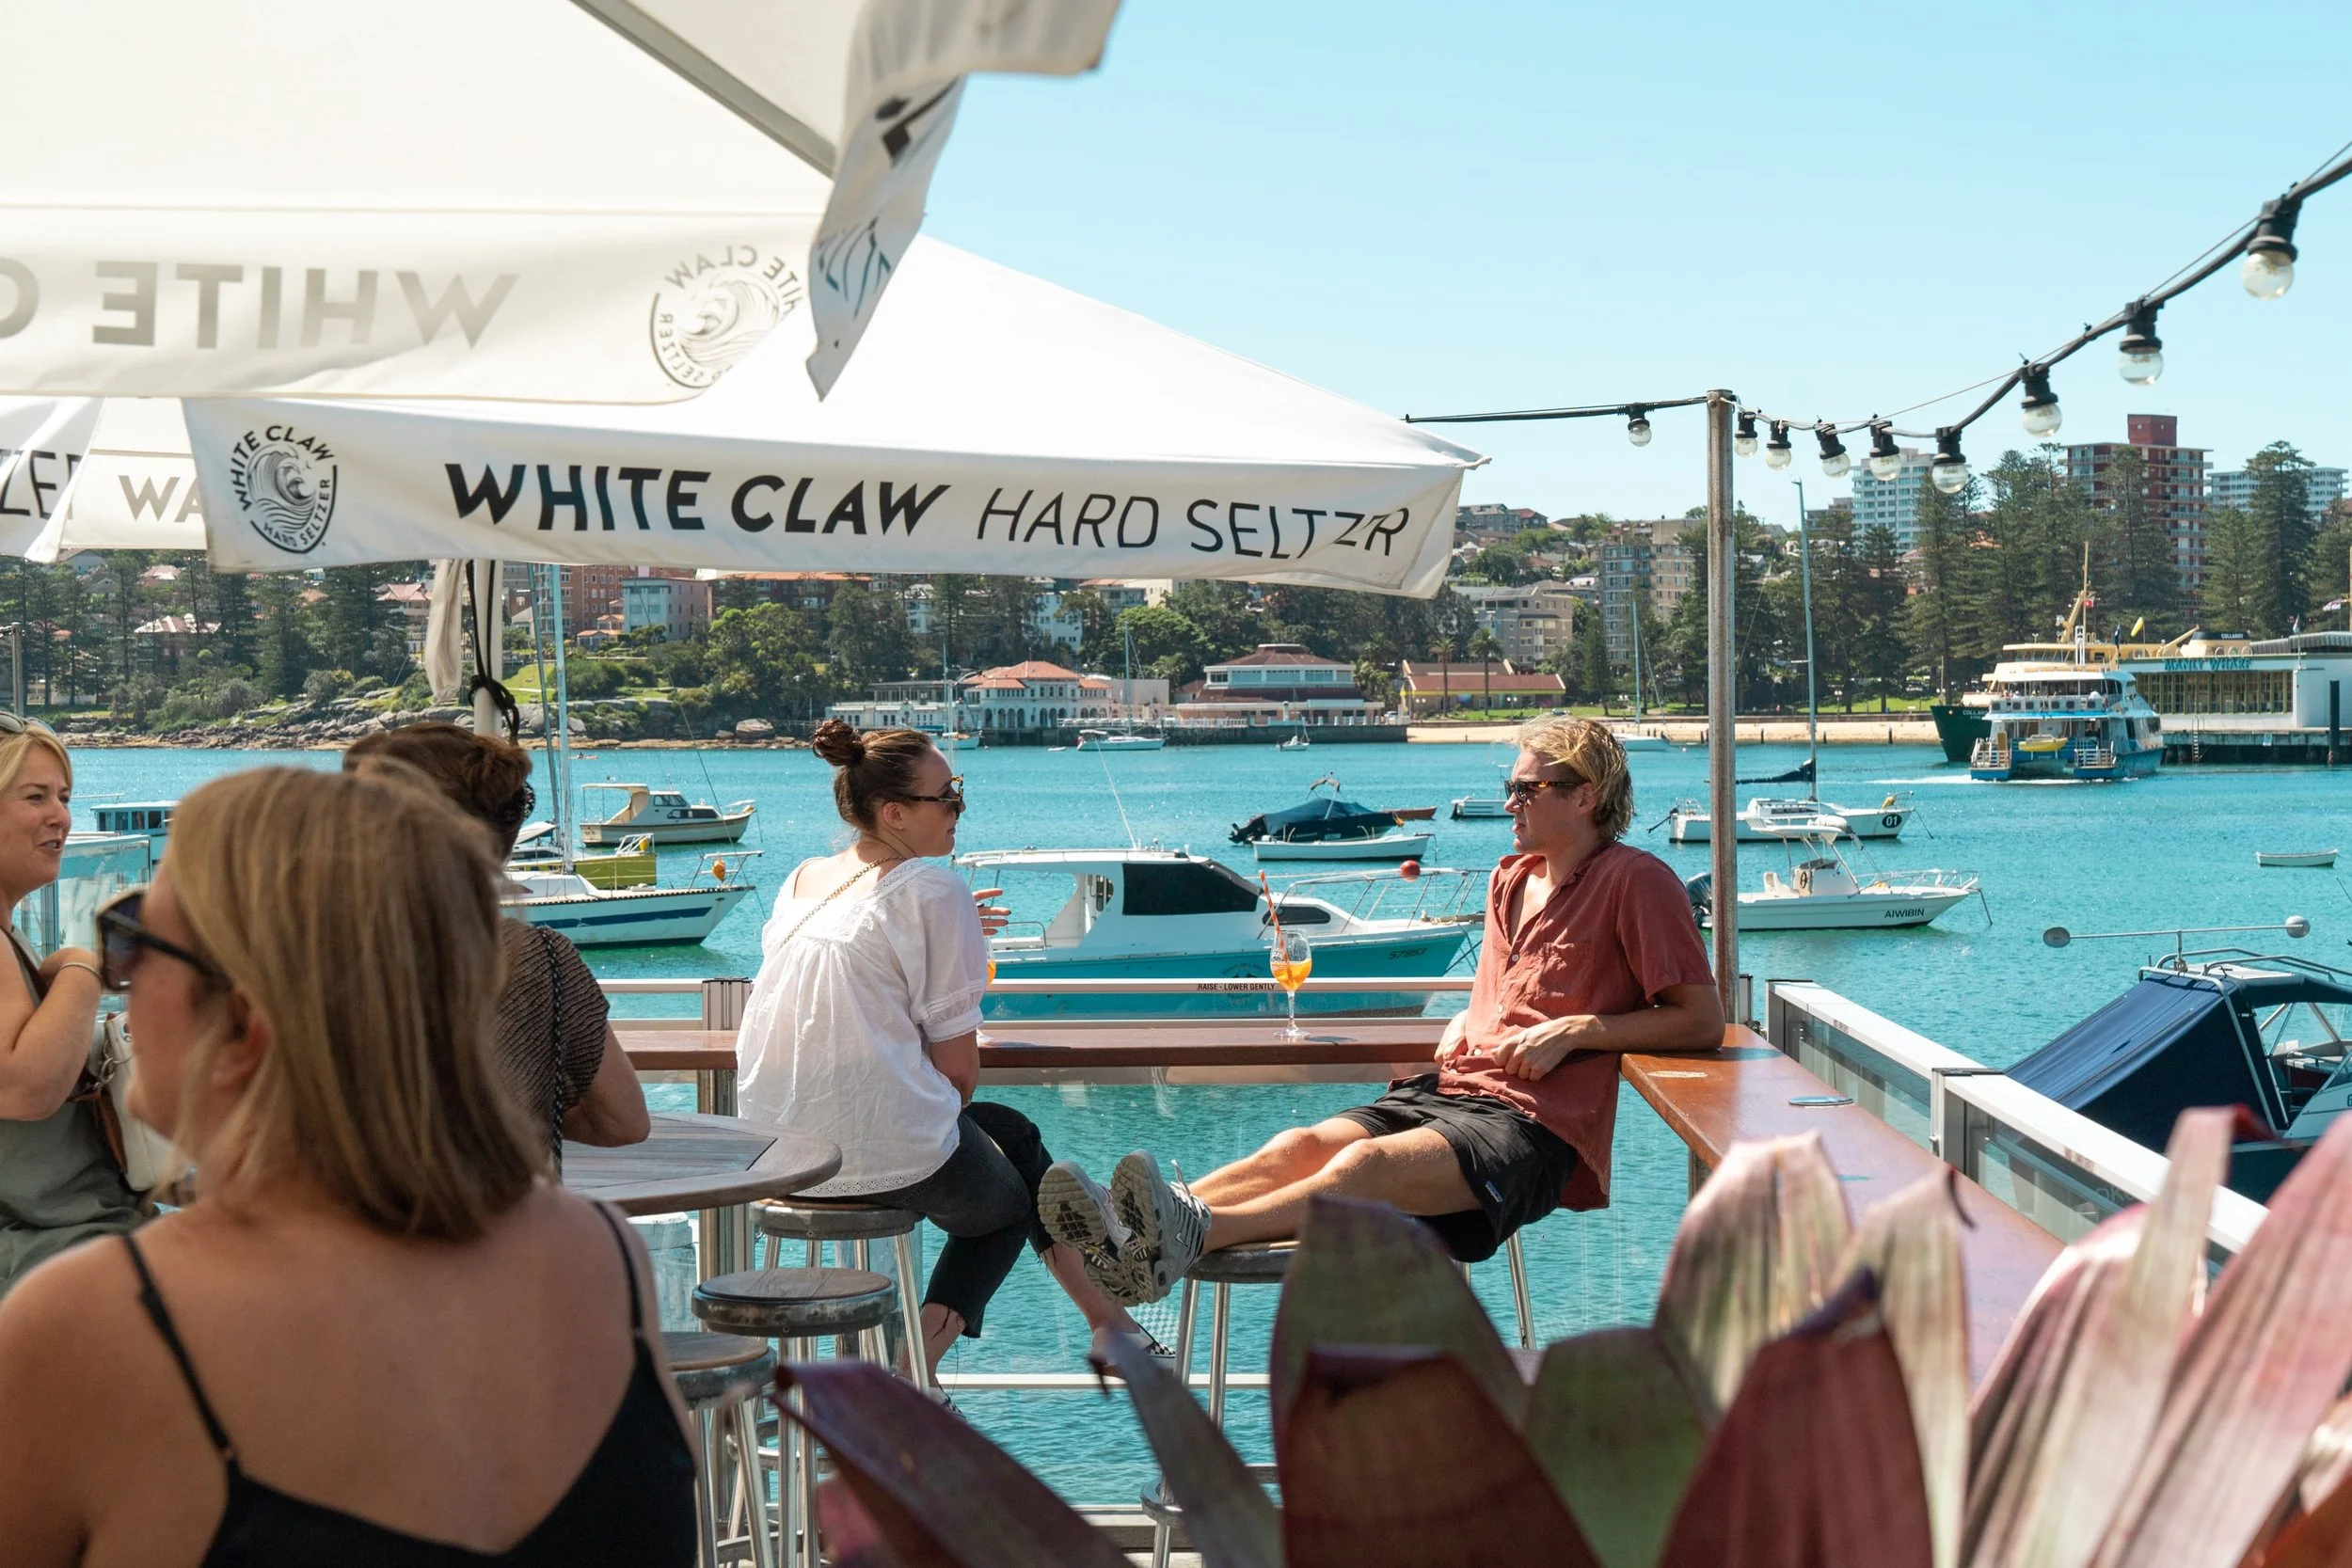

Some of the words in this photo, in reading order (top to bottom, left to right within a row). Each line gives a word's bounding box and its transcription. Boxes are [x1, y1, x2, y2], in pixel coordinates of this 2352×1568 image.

[230, 430, 262, 513] WHITE
[265, 425, 335, 462] CLAW
[299, 478, 331, 546] SELTZER
[444, 463, 712, 531] WHITE
[730, 474, 953, 537] CLAW
[977, 487, 1160, 548] HARD
[2165, 658, 2204, 671] MANLY
[2208, 657, 2252, 671] WHARF
[1885, 815, 1898, 827] 01
[1884, 908, 1925, 919] AIWIBIN
